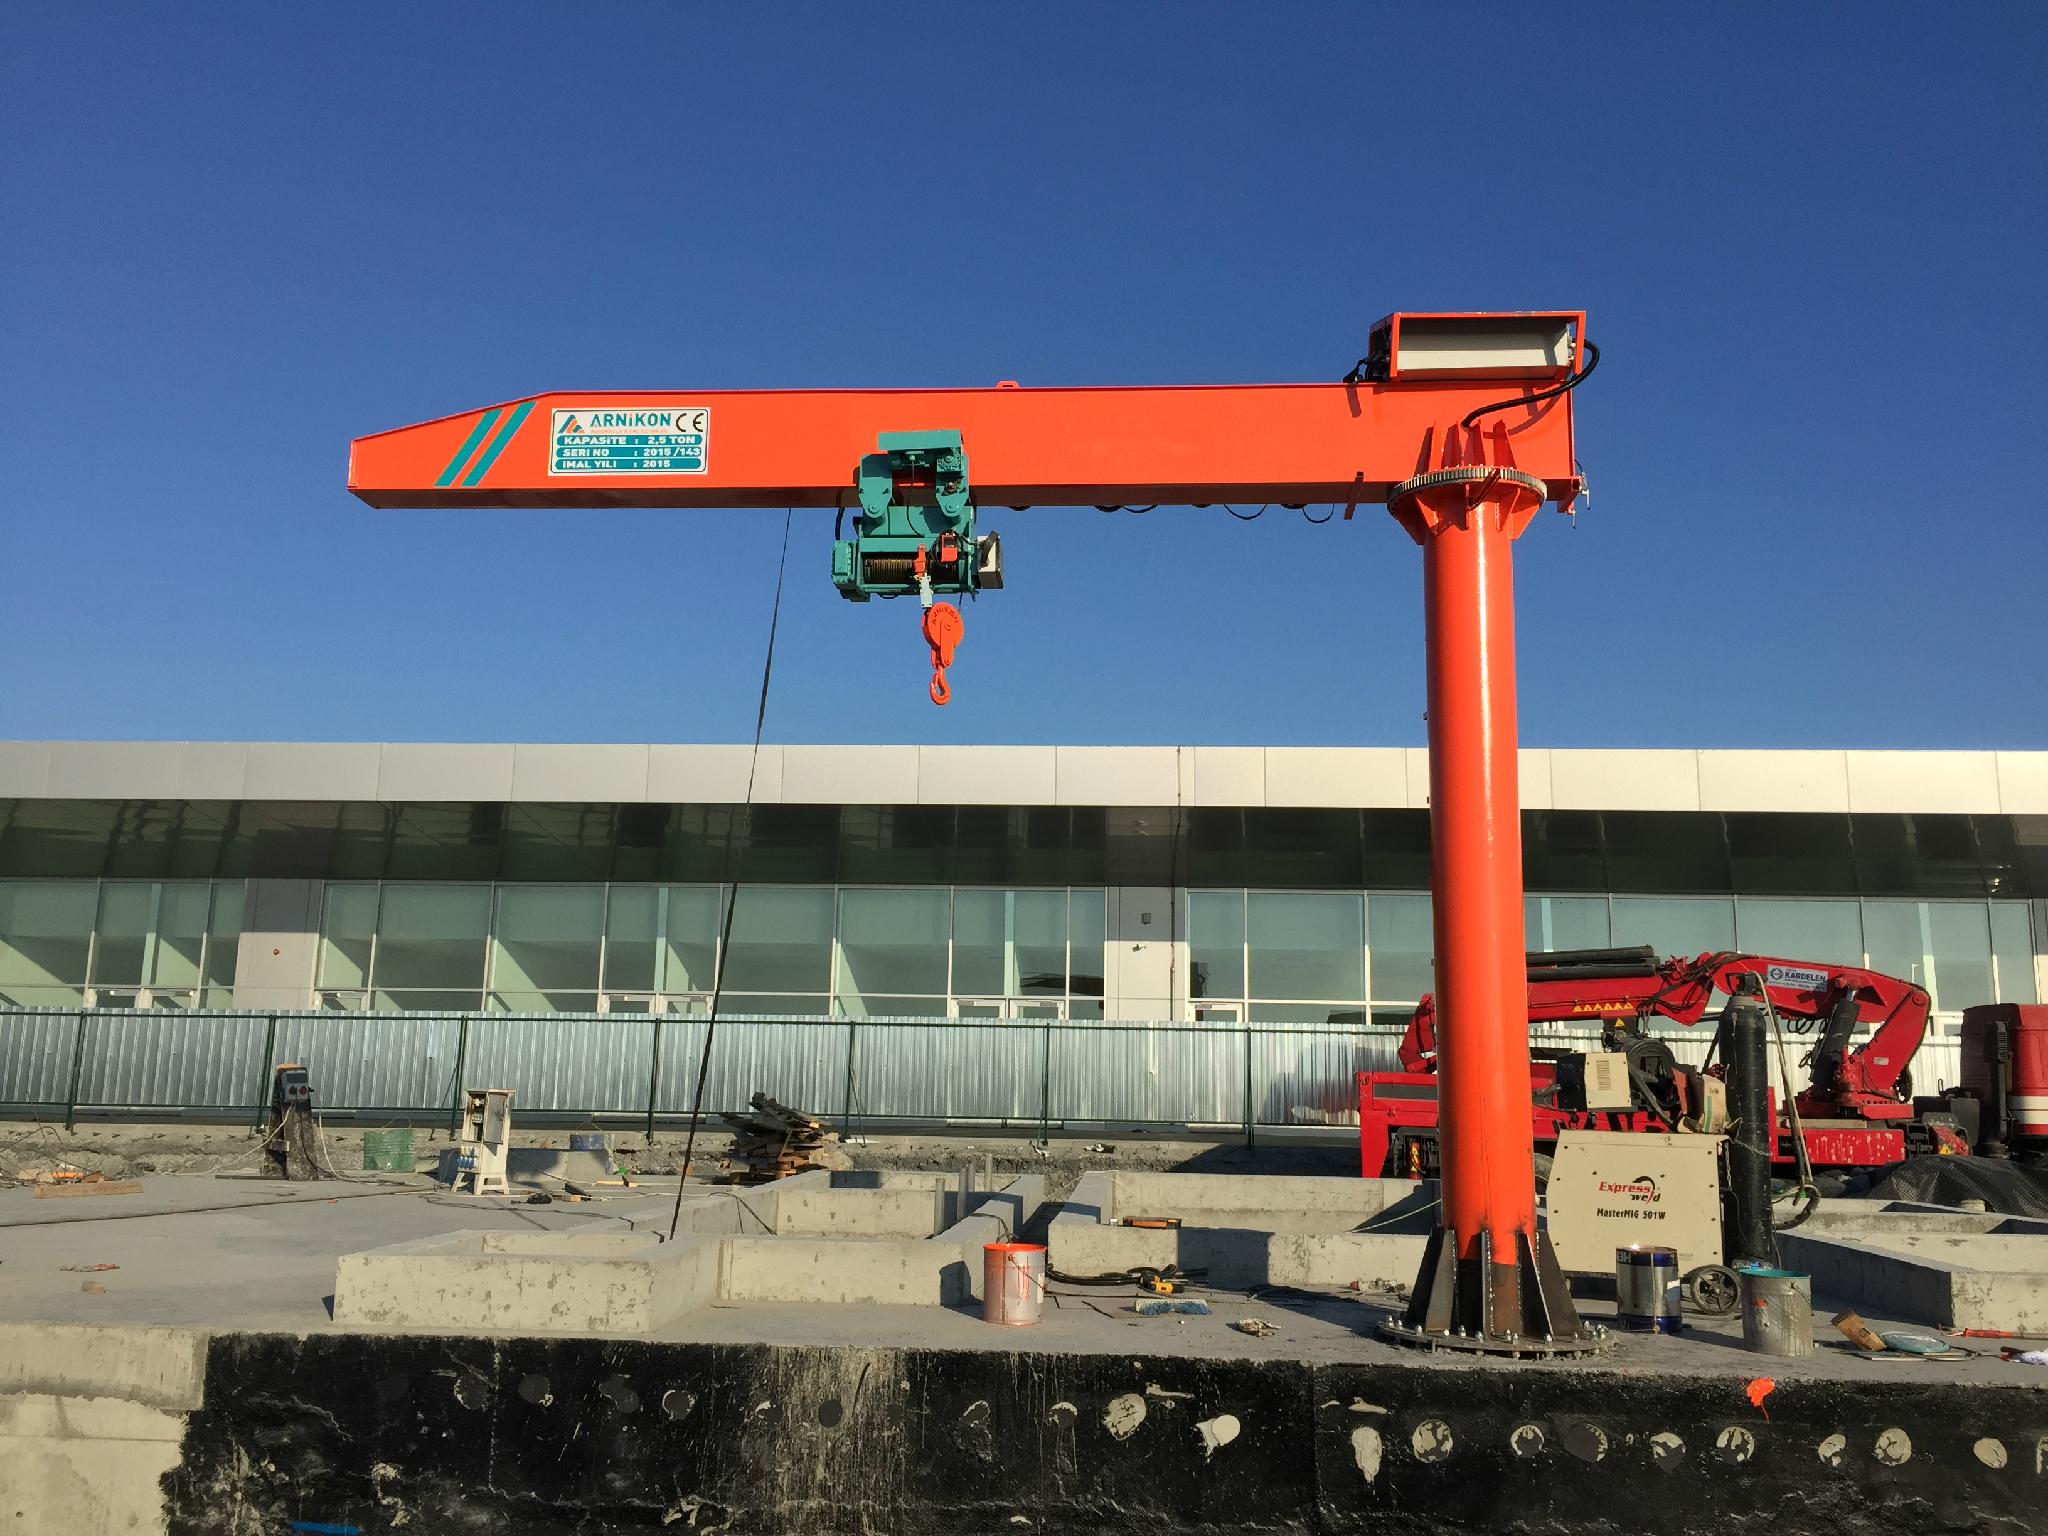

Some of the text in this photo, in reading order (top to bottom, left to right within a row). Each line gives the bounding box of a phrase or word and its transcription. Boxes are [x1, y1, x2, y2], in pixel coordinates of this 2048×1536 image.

[669, 436, 696, 444] TON
[592, 448, 610, 457] NO
[593, 460, 617, 468] YILI
[642, 459, 671, 468] 2015
[1784, 971, 1826, 982] KARDELEN
[1599, 1181, 1651, 1194] Express
[1630, 1190, 1661, 1205] weld
[1596, 1208, 1666, 1220] MasterMIG 501W
